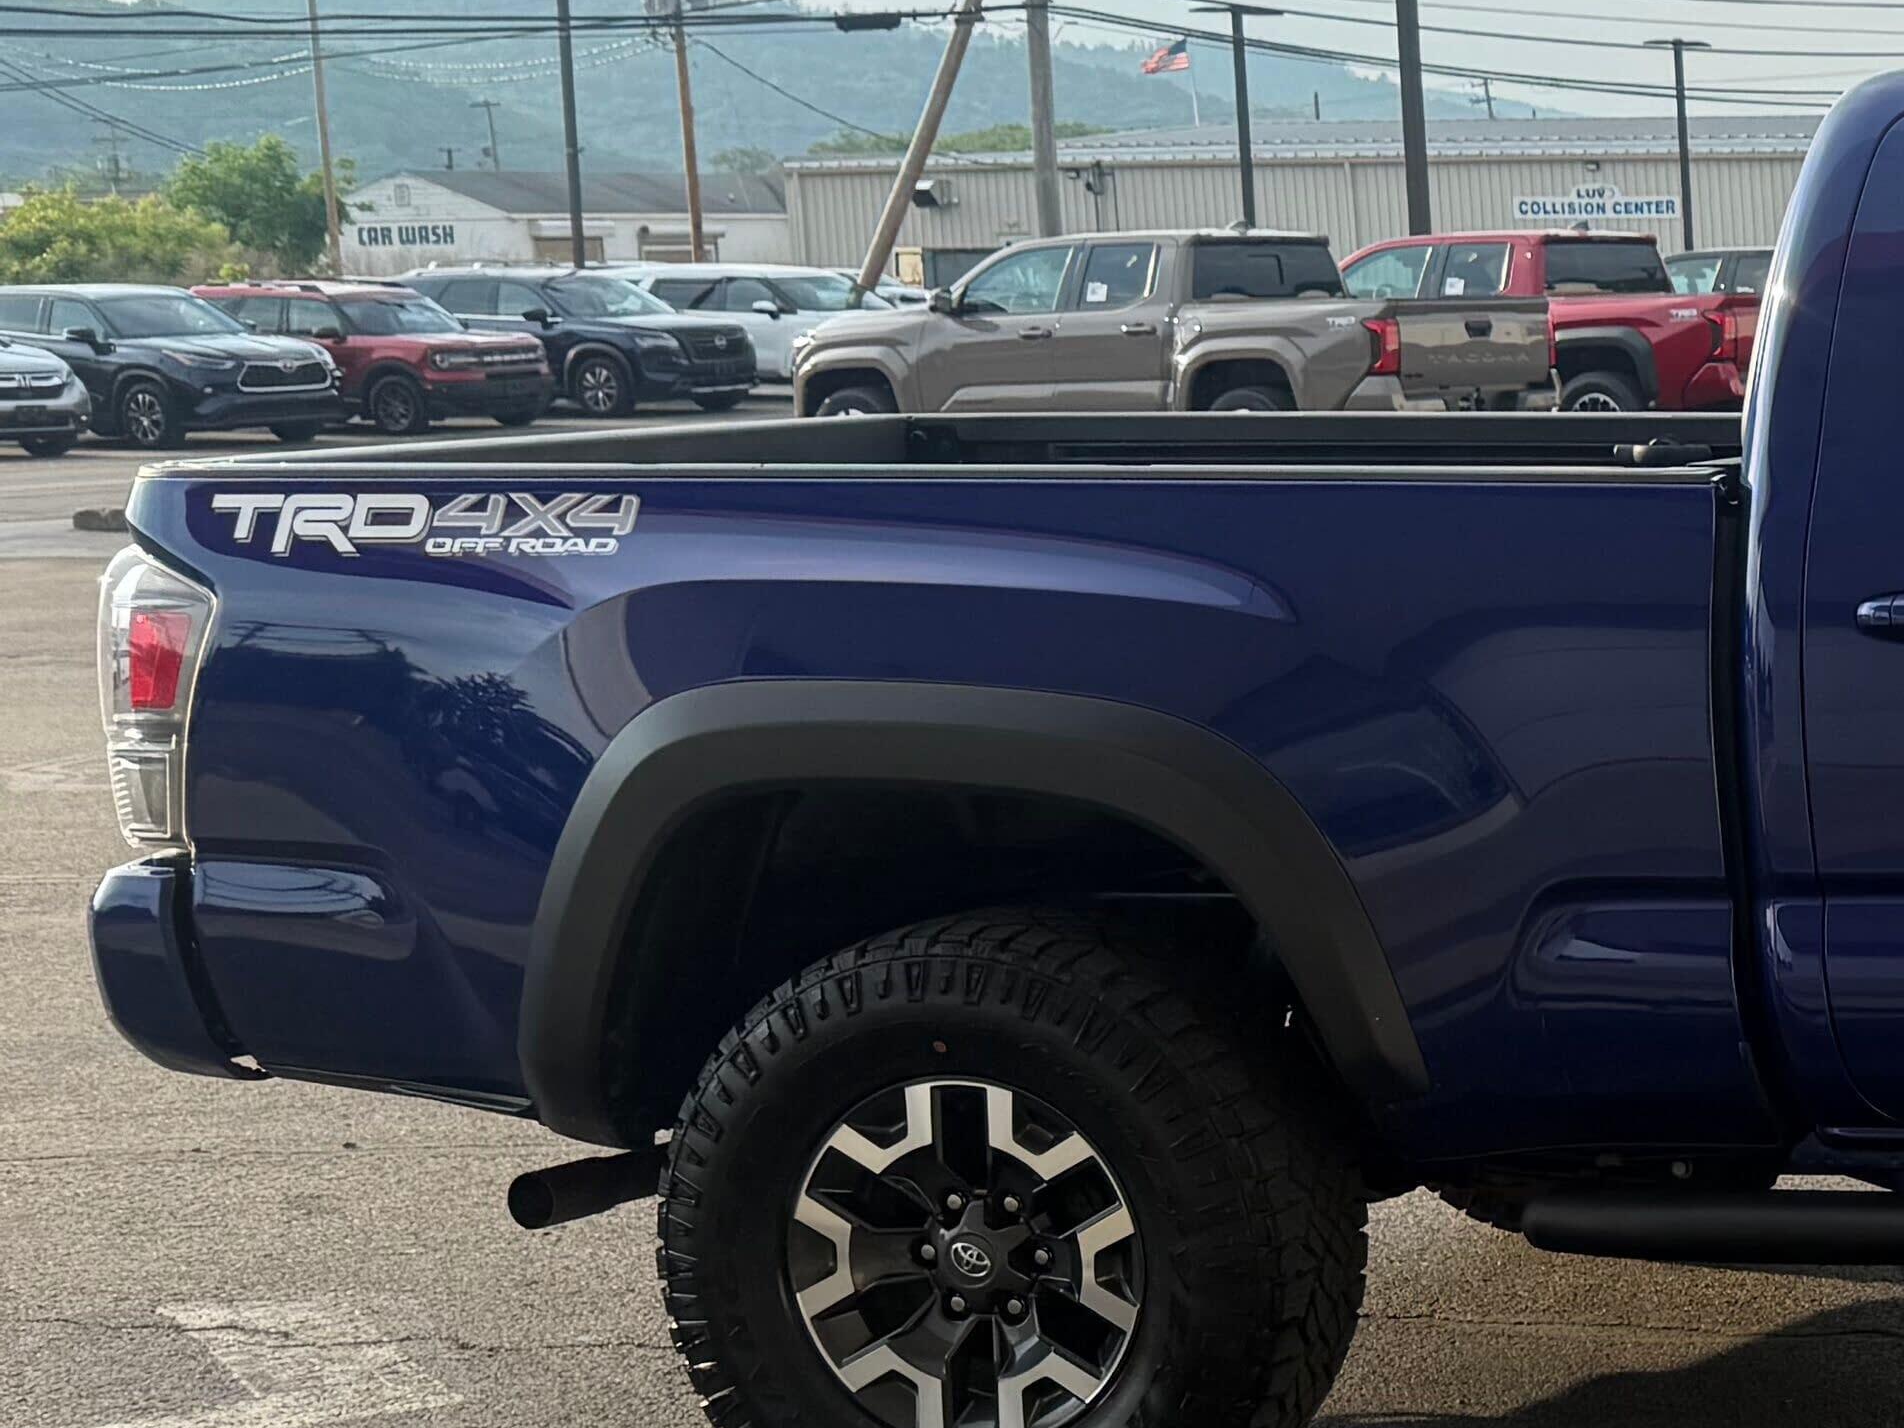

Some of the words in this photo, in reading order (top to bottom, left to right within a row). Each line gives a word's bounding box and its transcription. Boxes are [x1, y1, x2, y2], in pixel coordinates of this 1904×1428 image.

[1518, 201, 1606, 215] COLLISION
[1612, 199, 1676, 215] CENTER
[357, 226, 393, 246] CAR
[398, 224, 455, 245] WASH
[1427, 353, 1530, 364] TACOMA
[211, 493, 432, 557] TRD
[424, 536, 506, 556] OFF
[507, 536, 619, 557] ROAD
